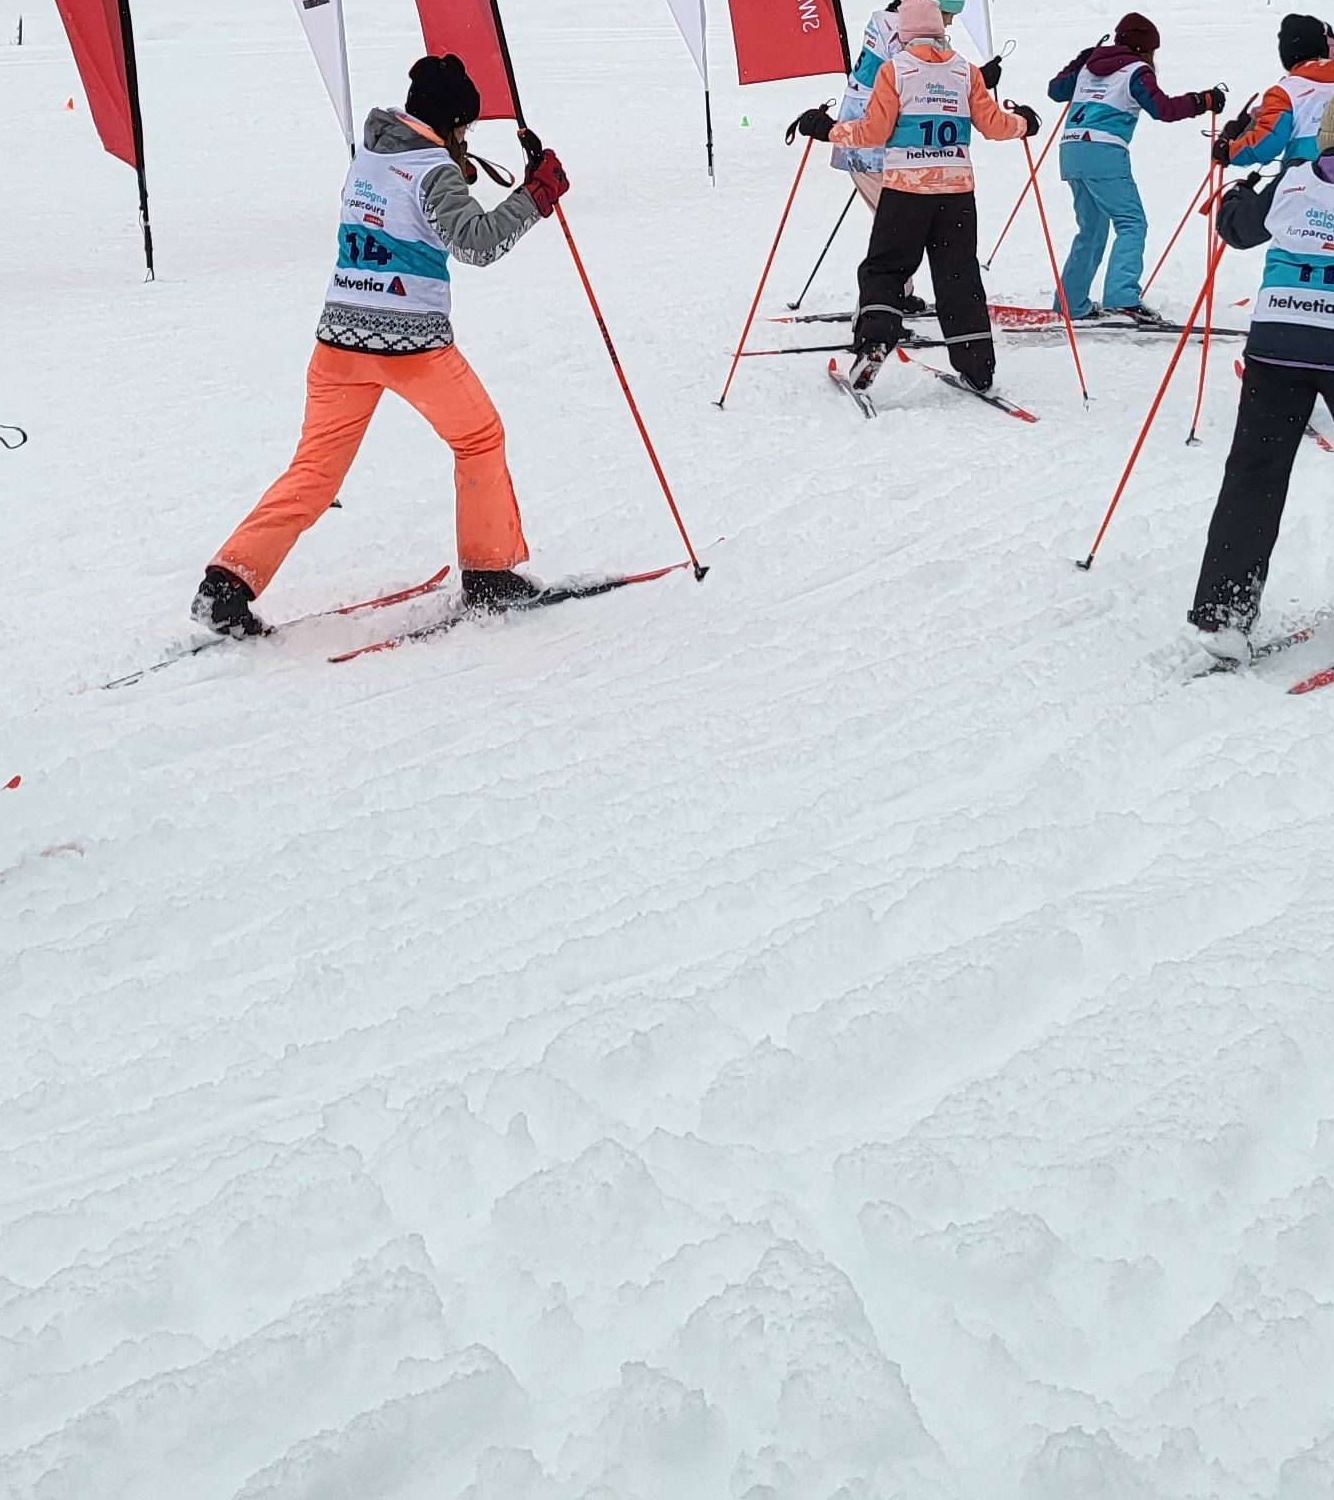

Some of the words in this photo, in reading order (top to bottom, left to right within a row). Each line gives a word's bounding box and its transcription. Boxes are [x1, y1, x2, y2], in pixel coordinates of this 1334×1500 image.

[1070, 104, 1086, 125] 4
[920, 119, 958, 146] 10
[907, 148, 954, 160] helvetia
[346, 232, 393, 266] 14
